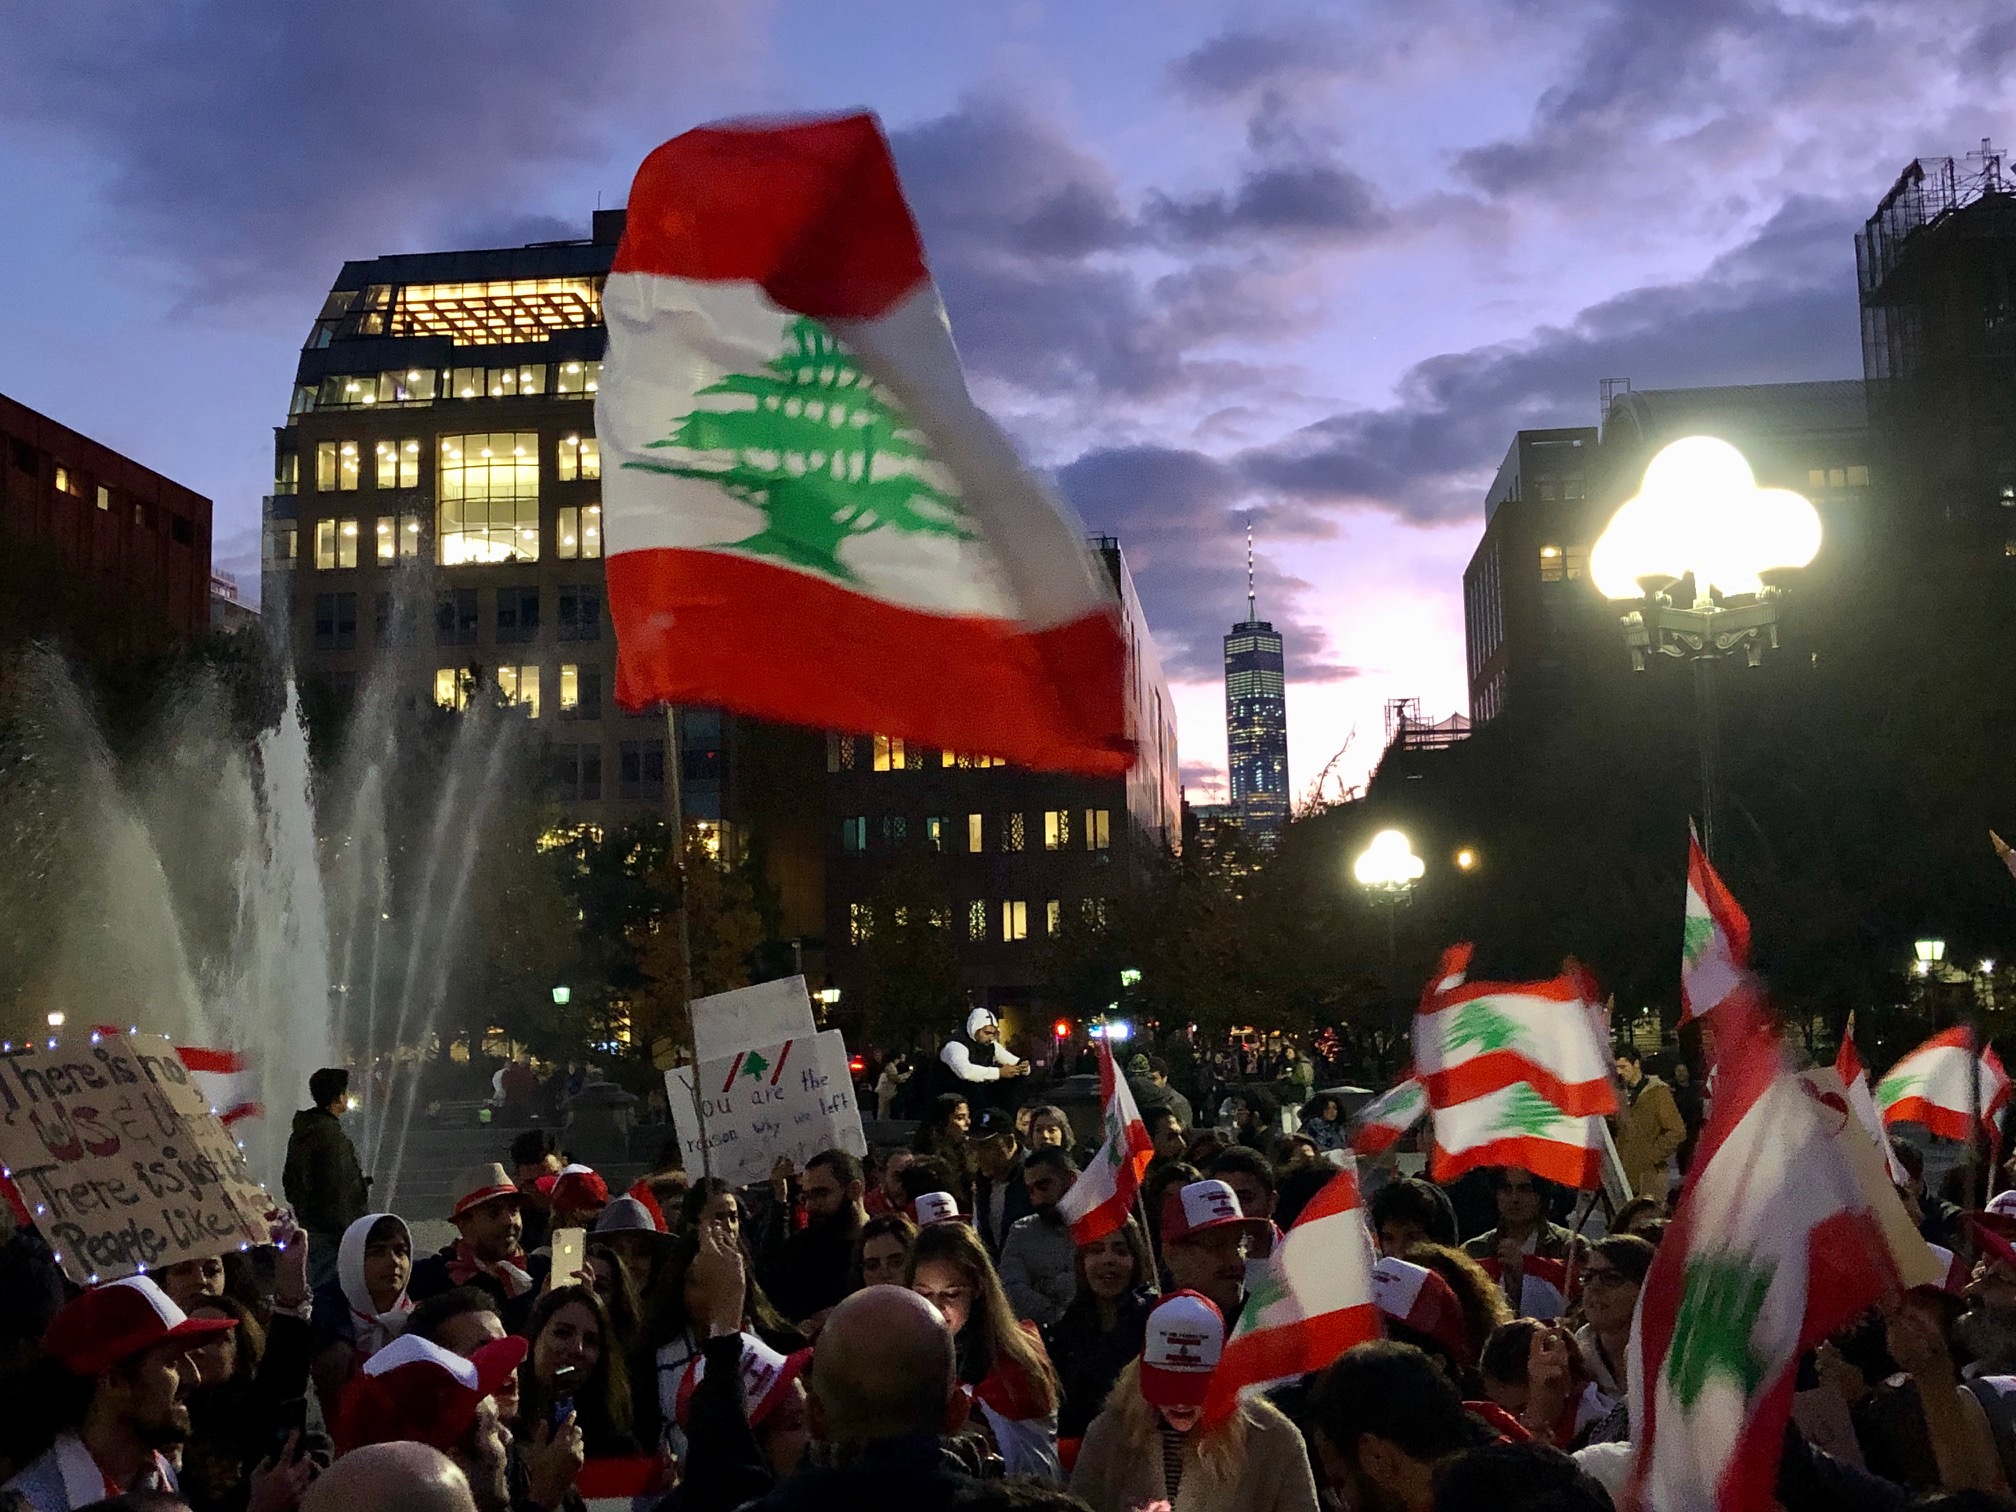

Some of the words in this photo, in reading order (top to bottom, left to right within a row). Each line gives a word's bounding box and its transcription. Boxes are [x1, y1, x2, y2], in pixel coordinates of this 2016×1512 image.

[93, 1047, 138, 1086] is
[136, 1054, 188, 1086] no
[678, 1074, 733, 1118] You
[751, 1085, 785, 1106] are
[801, 1067, 829, 1092] the
[686, 1128, 738, 1153] reason
[751, 1120, 781, 1138] why
[793, 1111, 811, 1124] we
[818, 1092, 849, 1116] left
[13, 1163, 140, 1219] There
[133, 1161, 186, 1198] is
[50, 1217, 168, 1278] People
